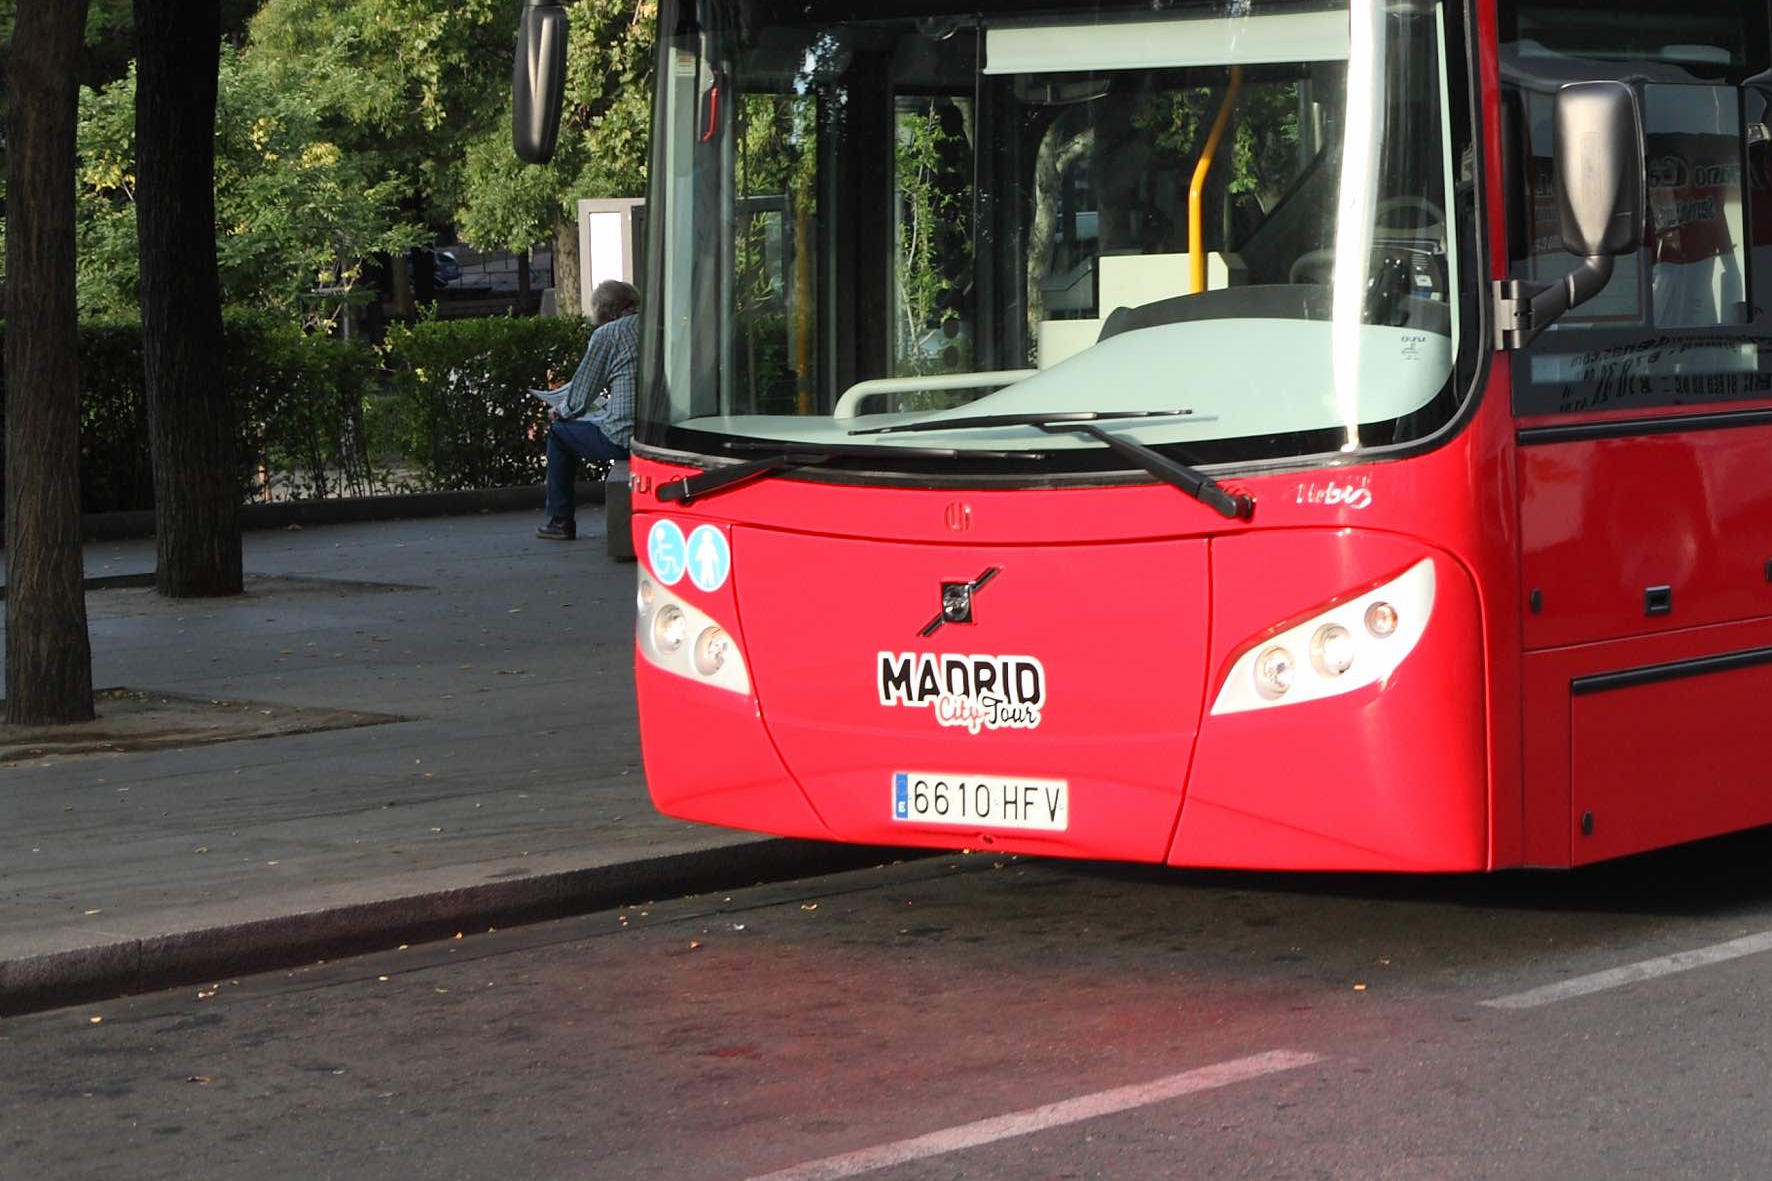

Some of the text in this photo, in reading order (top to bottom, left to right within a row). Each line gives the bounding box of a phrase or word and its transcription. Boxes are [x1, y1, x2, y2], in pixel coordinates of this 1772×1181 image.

[882, 657, 1041, 706] MADRID
[938, 695, 1038, 729] City Tour
[913, 779, 991, 818] 6610
[1002, 784, 1061, 823] HFV
